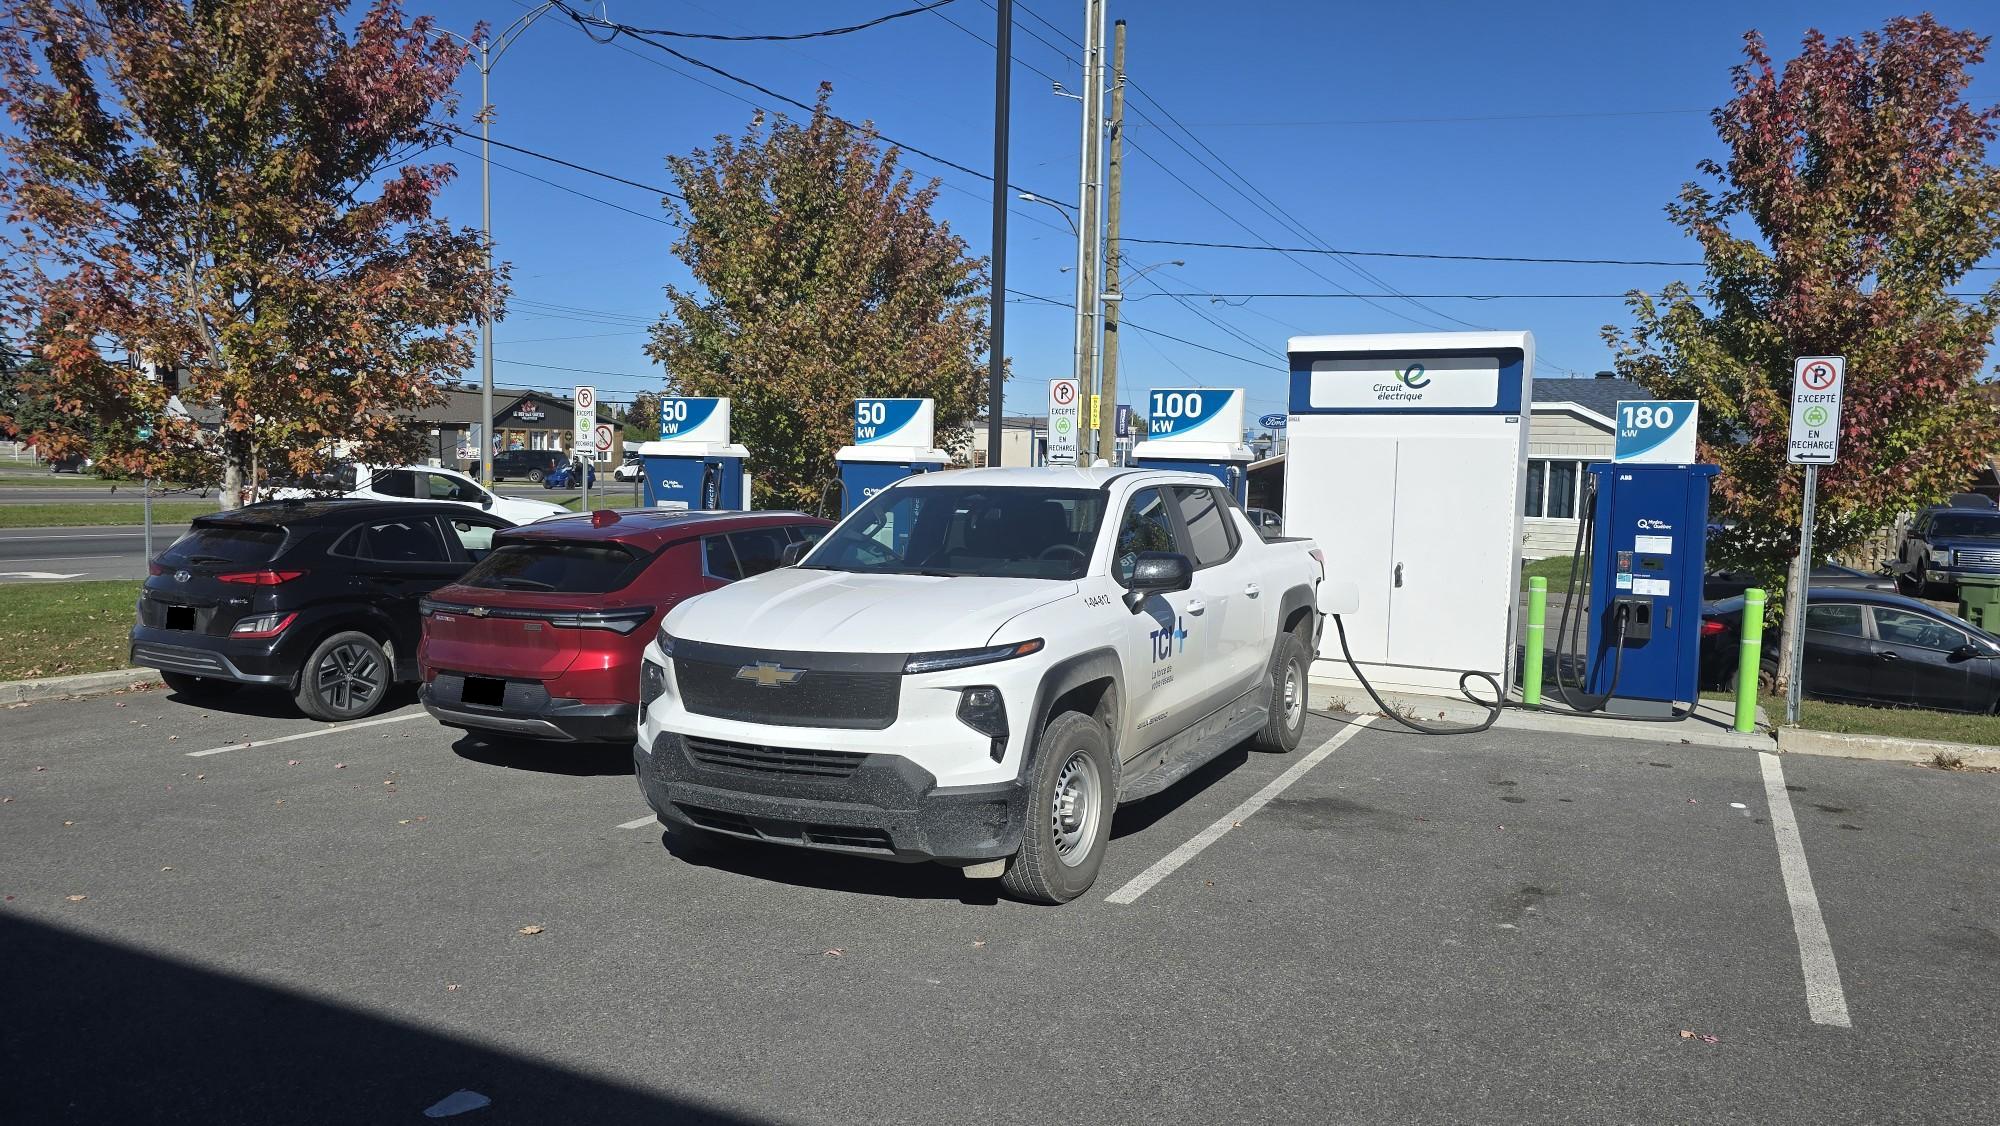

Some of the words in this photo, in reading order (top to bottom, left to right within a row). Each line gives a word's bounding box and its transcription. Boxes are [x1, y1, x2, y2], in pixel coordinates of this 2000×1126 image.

[1372, 383, 1403, 392] Circuit
[1377, 391, 1423, 402] électrique
[1797, 394, 1836, 403] EXCEPTÉ
[662, 400, 687, 421] 50
[1152, 392, 1203, 418] 100
[857, 402, 886, 425] 50
[1622, 406, 1674, 429] 180
[1151, 420, 1174, 433] kW
[1265, 416, 1287, 426] Ford
[662, 423, 679, 434] kW
[857, 426, 876, 438] kW
[1621, 429, 1638, 437] kW
[1808, 430, 1820, 438] EN
[1049, 444, 1076, 452] RECHARGE
[1791, 440, 1835, 449] RECHARGE
